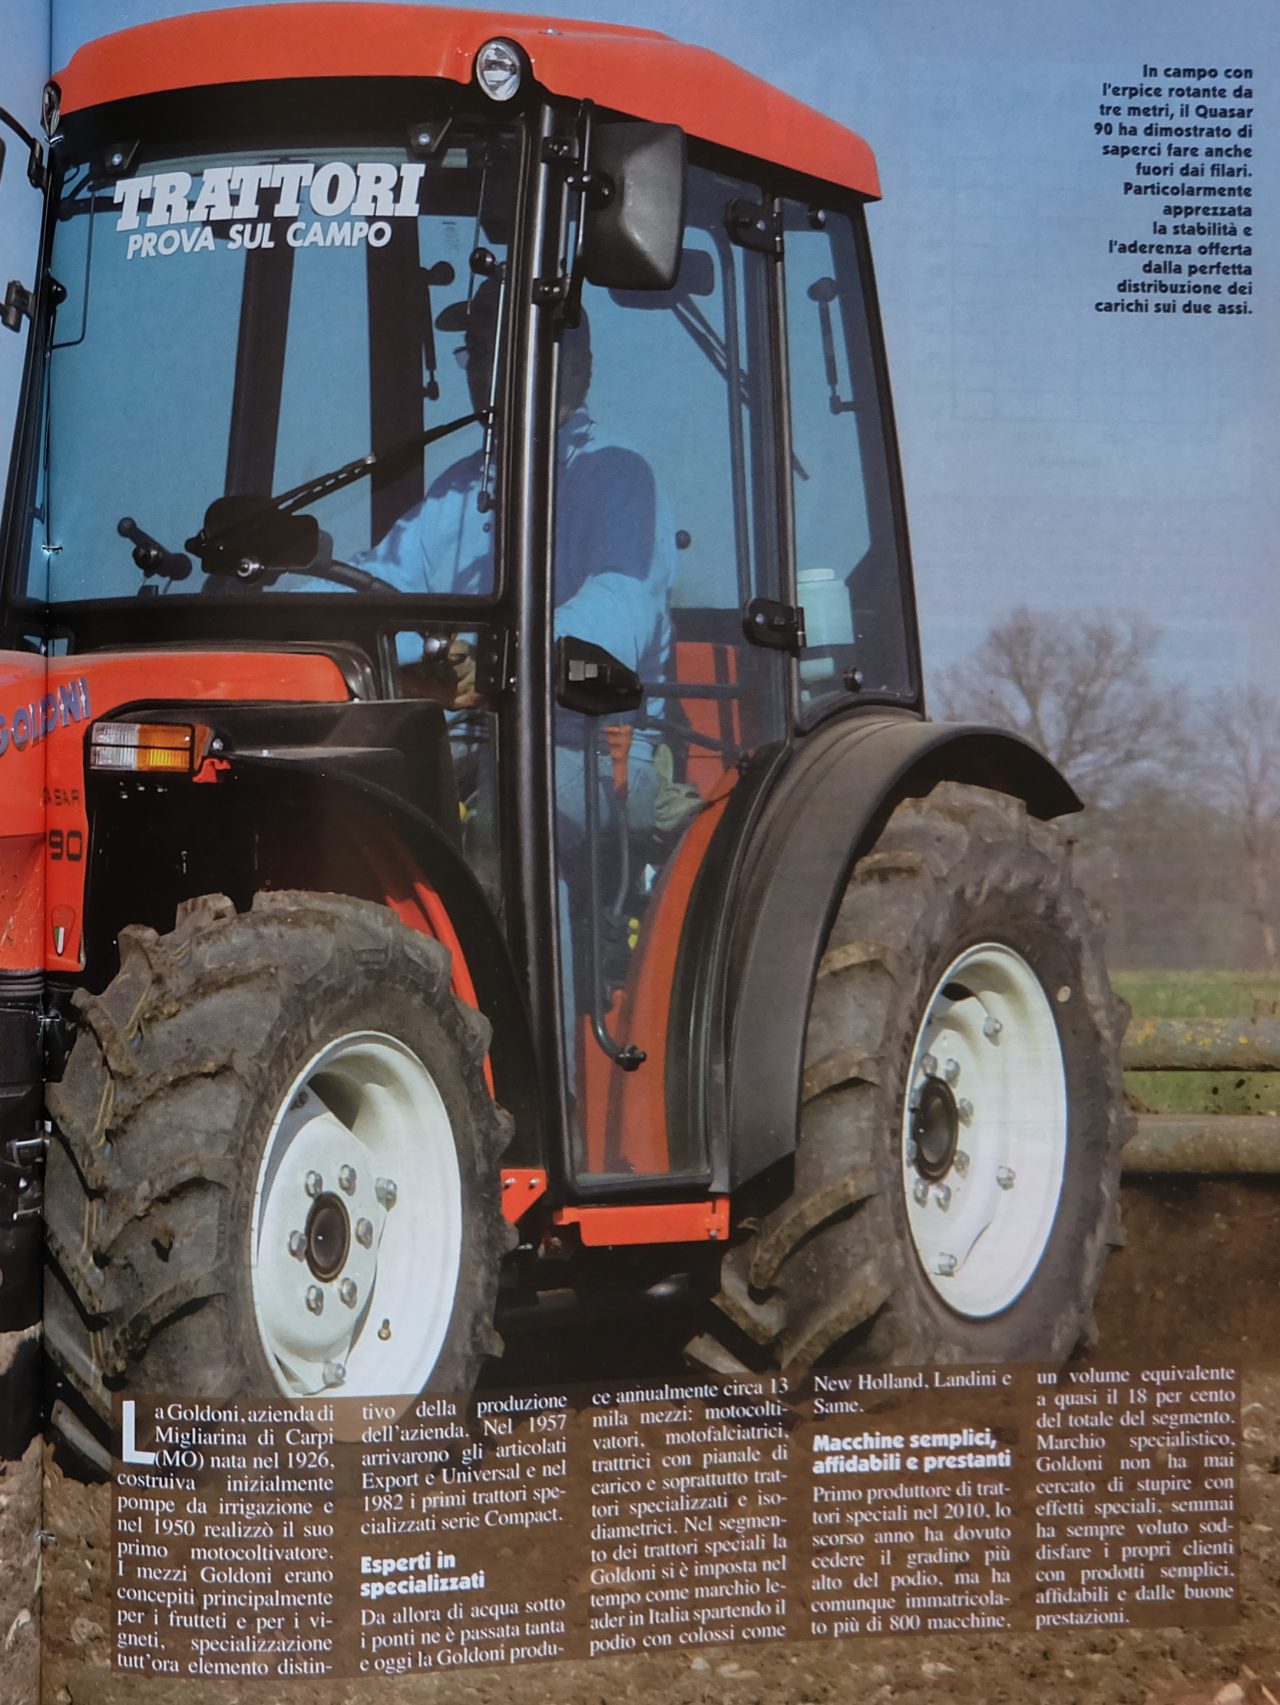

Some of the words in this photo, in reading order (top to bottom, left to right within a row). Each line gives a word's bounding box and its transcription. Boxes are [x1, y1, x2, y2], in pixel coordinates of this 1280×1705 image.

[1143, 64, 1158, 77] In
[1164, 68, 1218, 81] campo
[1224, 69, 1253, 79] con
[1103, 83, 1162, 100] l'erpice
[1168, 86, 1227, 99] rotante
[1233, 85, 1253, 99] da
[1100, 104, 1122, 116] tre
[1128, 104, 1174, 120] metri,
[1180, 104, 1189, 117] il
[1195, 105, 1254, 119] Quasar
[1094, 122, 1113, 135] 90
[1119, 122, 1137, 136] ha
[1144, 123, 1232, 138] dimostrato
[1238, 124, 1252, 138] di
[1103, 143, 1161, 158] saperci
[1167, 144, 1199, 157] fare
[1205, 144, 1252, 158] anche
[1136, 162, 1174, 176] fuori
[1180, 164, 1205, 177] dai
[1210, 164, 1252, 177] filari.
[113, 162, 426, 231] TRATTORI
[1124, 182, 1252, 197] Particolarmente
[1163, 205, 1252, 218] apprezzata
[1154, 222, 1167, 235] la
[1173, 222, 1237, 236] stabilità
[1243, 226, 1252, 237] e
[126, 226, 215, 260] PROVA
[226, 222, 274, 250] SUL
[286, 221, 392, 248] CAMPO
[1110, 240, 1192, 255] l'aderenza
[1198, 242, 1252, 256] offerta
[1143, 260, 1182, 274] dalla
[1188, 262, 1252, 277] perfetta
[1118, 280, 1222, 295] distribuzione
[1228, 282, 1252, 295] dei
[1095, 299, 1149, 313] carichi
[1154, 300, 1176, 313] sui
[1182, 300, 1212, 314] due
[1218, 301, 1253, 315] assi.
[49, 829, 83, 861] 90
[813, 1432, 904, 1452] Macchine
[910, 1428, 997, 1450] semplici,
[813, 1453, 901, 1474] affidabili
[906, 1457, 918, 1470] e
[924, 1450, 1011, 1473] prestanti
[118, 1497, 175, 1516] pompe
[187, 1498, 207, 1514] da
[220, 1498, 312, 1520] irrigazione
[324, 1502, 333, 1514] e
[362, 1552, 431, 1576] Esperti
[438, 1551, 456, 1569] in
[361, 1570, 485, 1600] specializzati
[1036, 1586, 1108, 1604] affidabili
[1118, 1590, 1127, 1601] e
[1136, 1584, 1175, 1601] dalle
[1185, 1584, 1234, 1599] buone
[362, 1610, 385, 1626] Da
[393, 1607, 440, 1624] allora
[448, 1603, 463, 1619] di
[471, 1604, 519, 1620] acqua
[526, 1599, 565, 1613] sotto
[1036, 1608, 1129, 1630] prestazioni.
